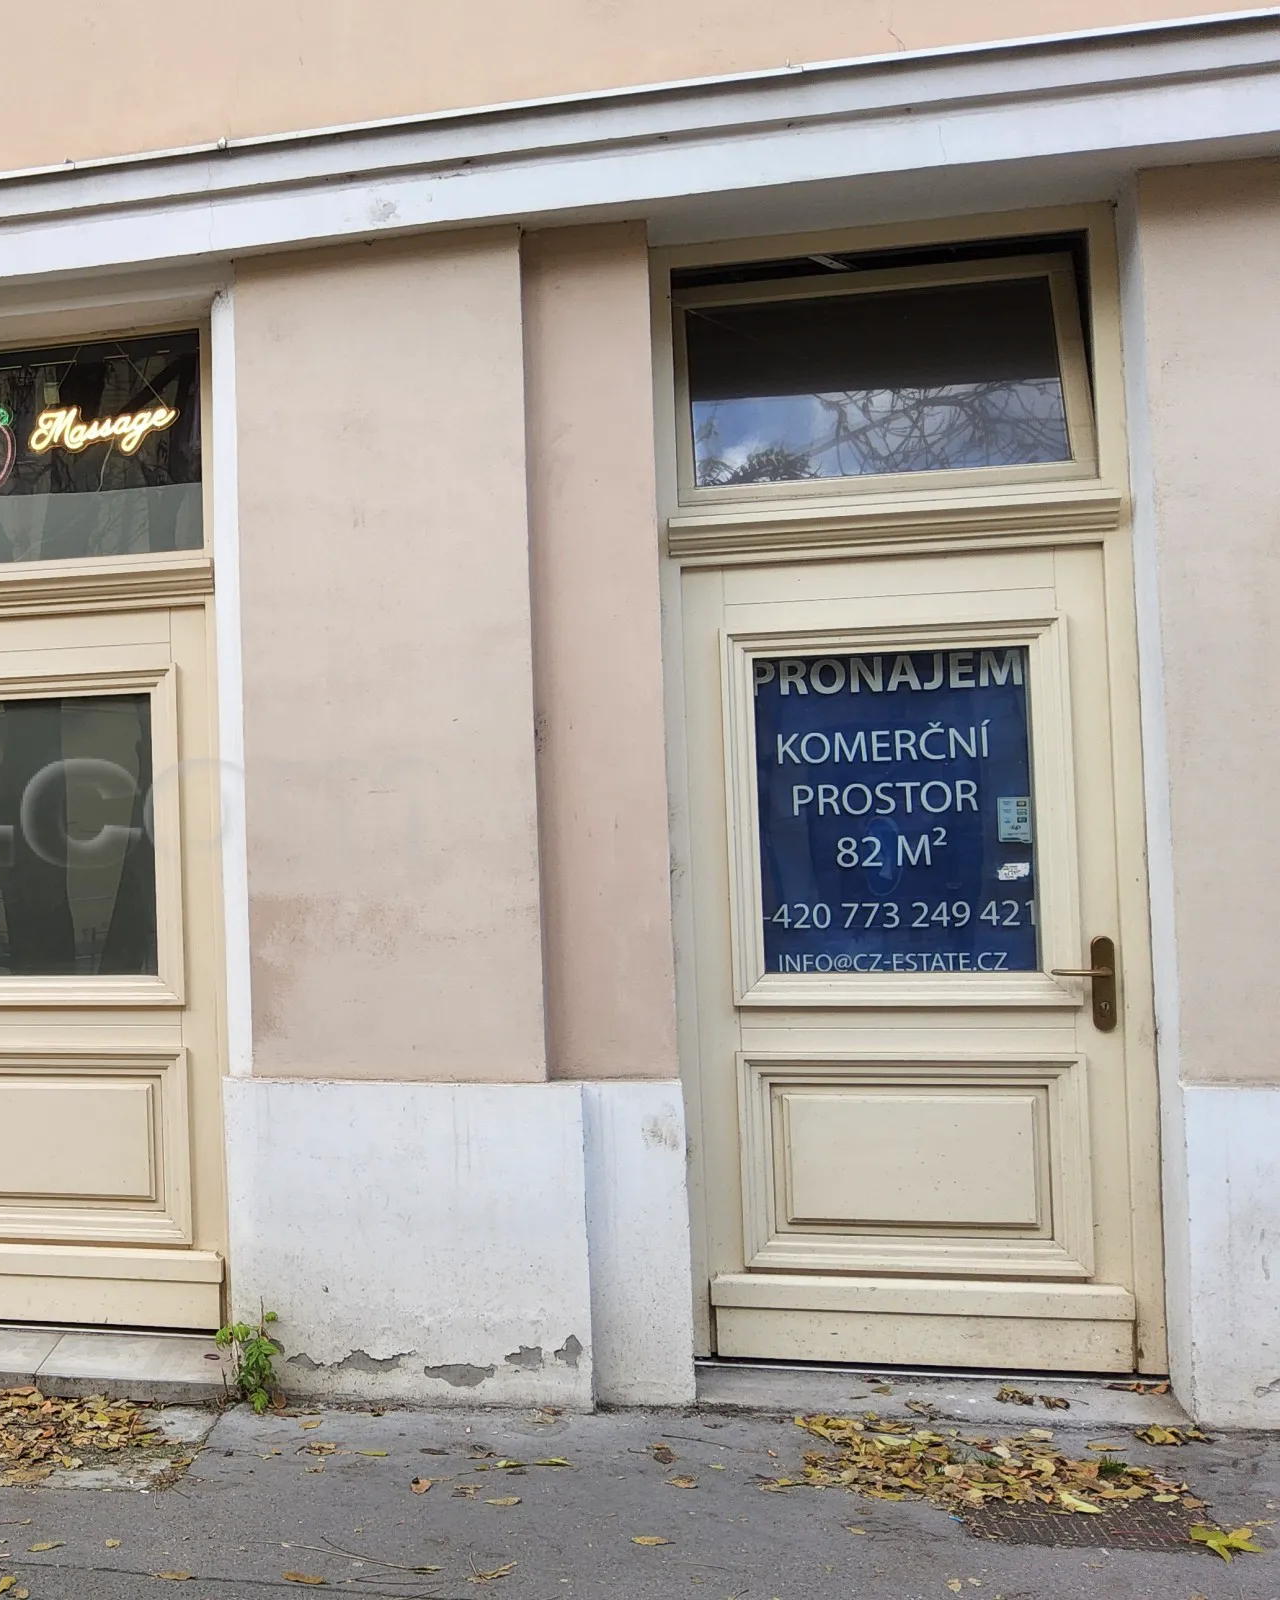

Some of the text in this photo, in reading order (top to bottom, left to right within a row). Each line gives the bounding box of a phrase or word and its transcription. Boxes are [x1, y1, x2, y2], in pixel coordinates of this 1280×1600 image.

[29, 407, 176, 452] Massage
[777, 719, 991, 765] KOMERČNÍ
[792, 780, 980, 816] PROSTOR
[836, 837, 883, 868] 82
[841, 902, 900, 929] 773
[911, 901, 971, 928] 249
[979, 900, 1036, 926] 421
[778, 951, 1009, 973] INFO@CZ-ESTATE.CZ
